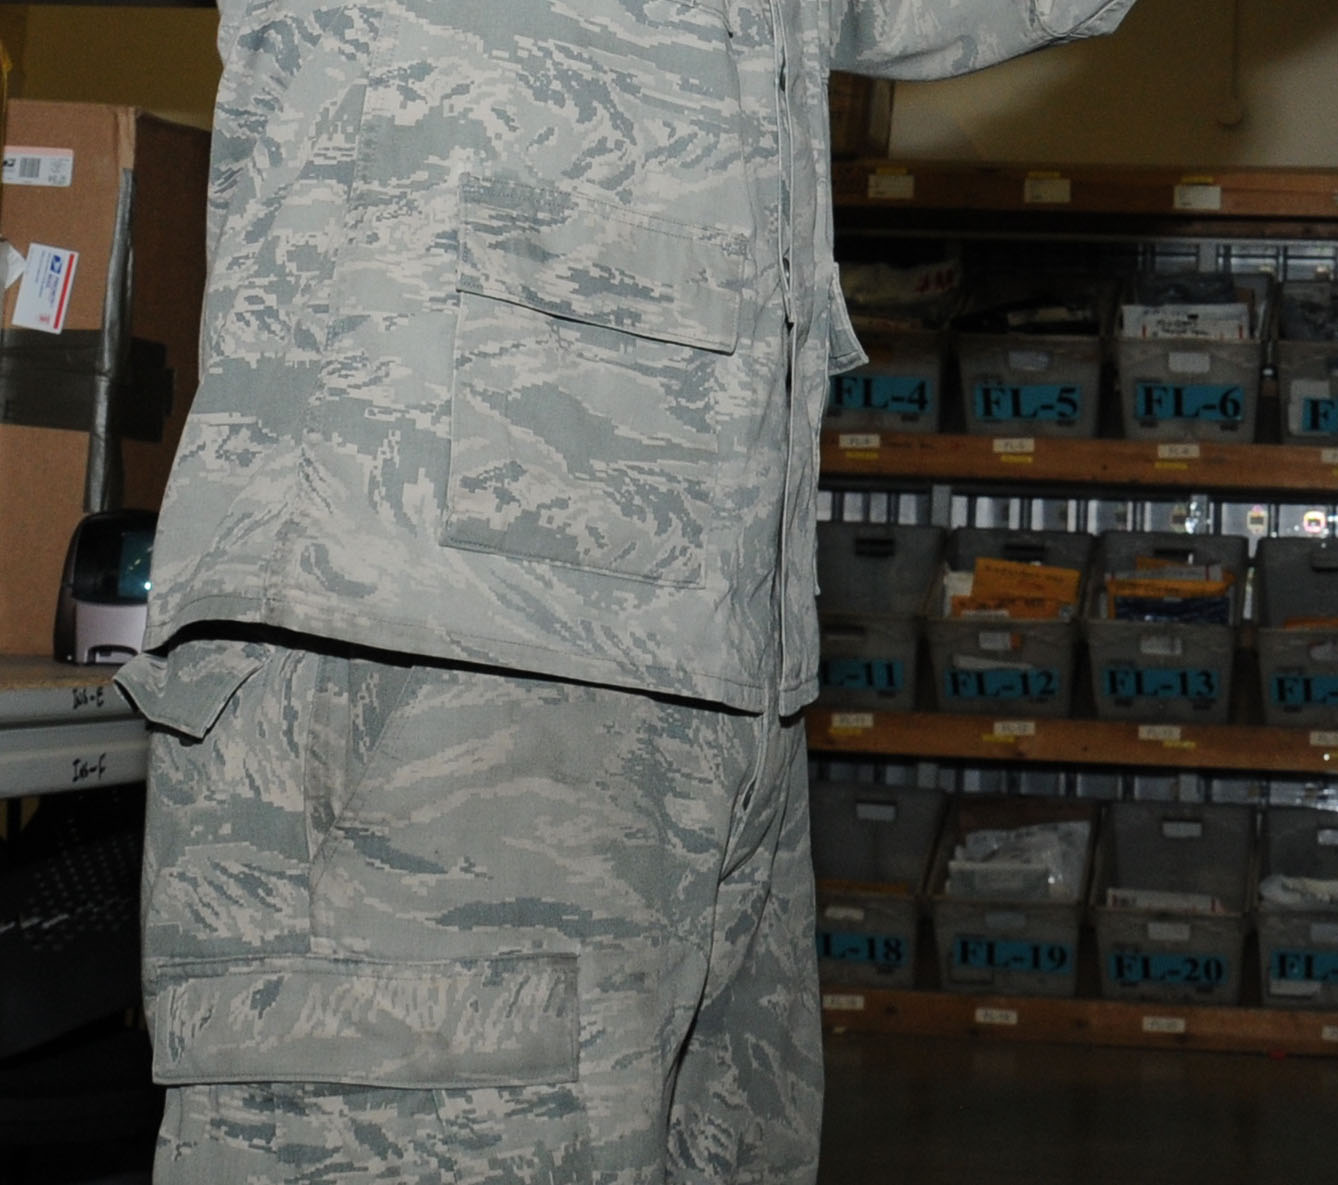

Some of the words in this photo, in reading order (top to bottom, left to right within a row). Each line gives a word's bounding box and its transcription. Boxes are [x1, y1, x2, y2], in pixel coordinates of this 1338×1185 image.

[834, 377, 927, 409] FL-4
[981, 386, 1078, 418] FL-5
[1143, 386, 1241, 417] FL-6
[951, 671, 1055, 696] FL-12
[1108, 670, 1214, 696] FL-13
[959, 940, 1067, 969] FL-19
[1114, 955, 1224, 981] FL-20
